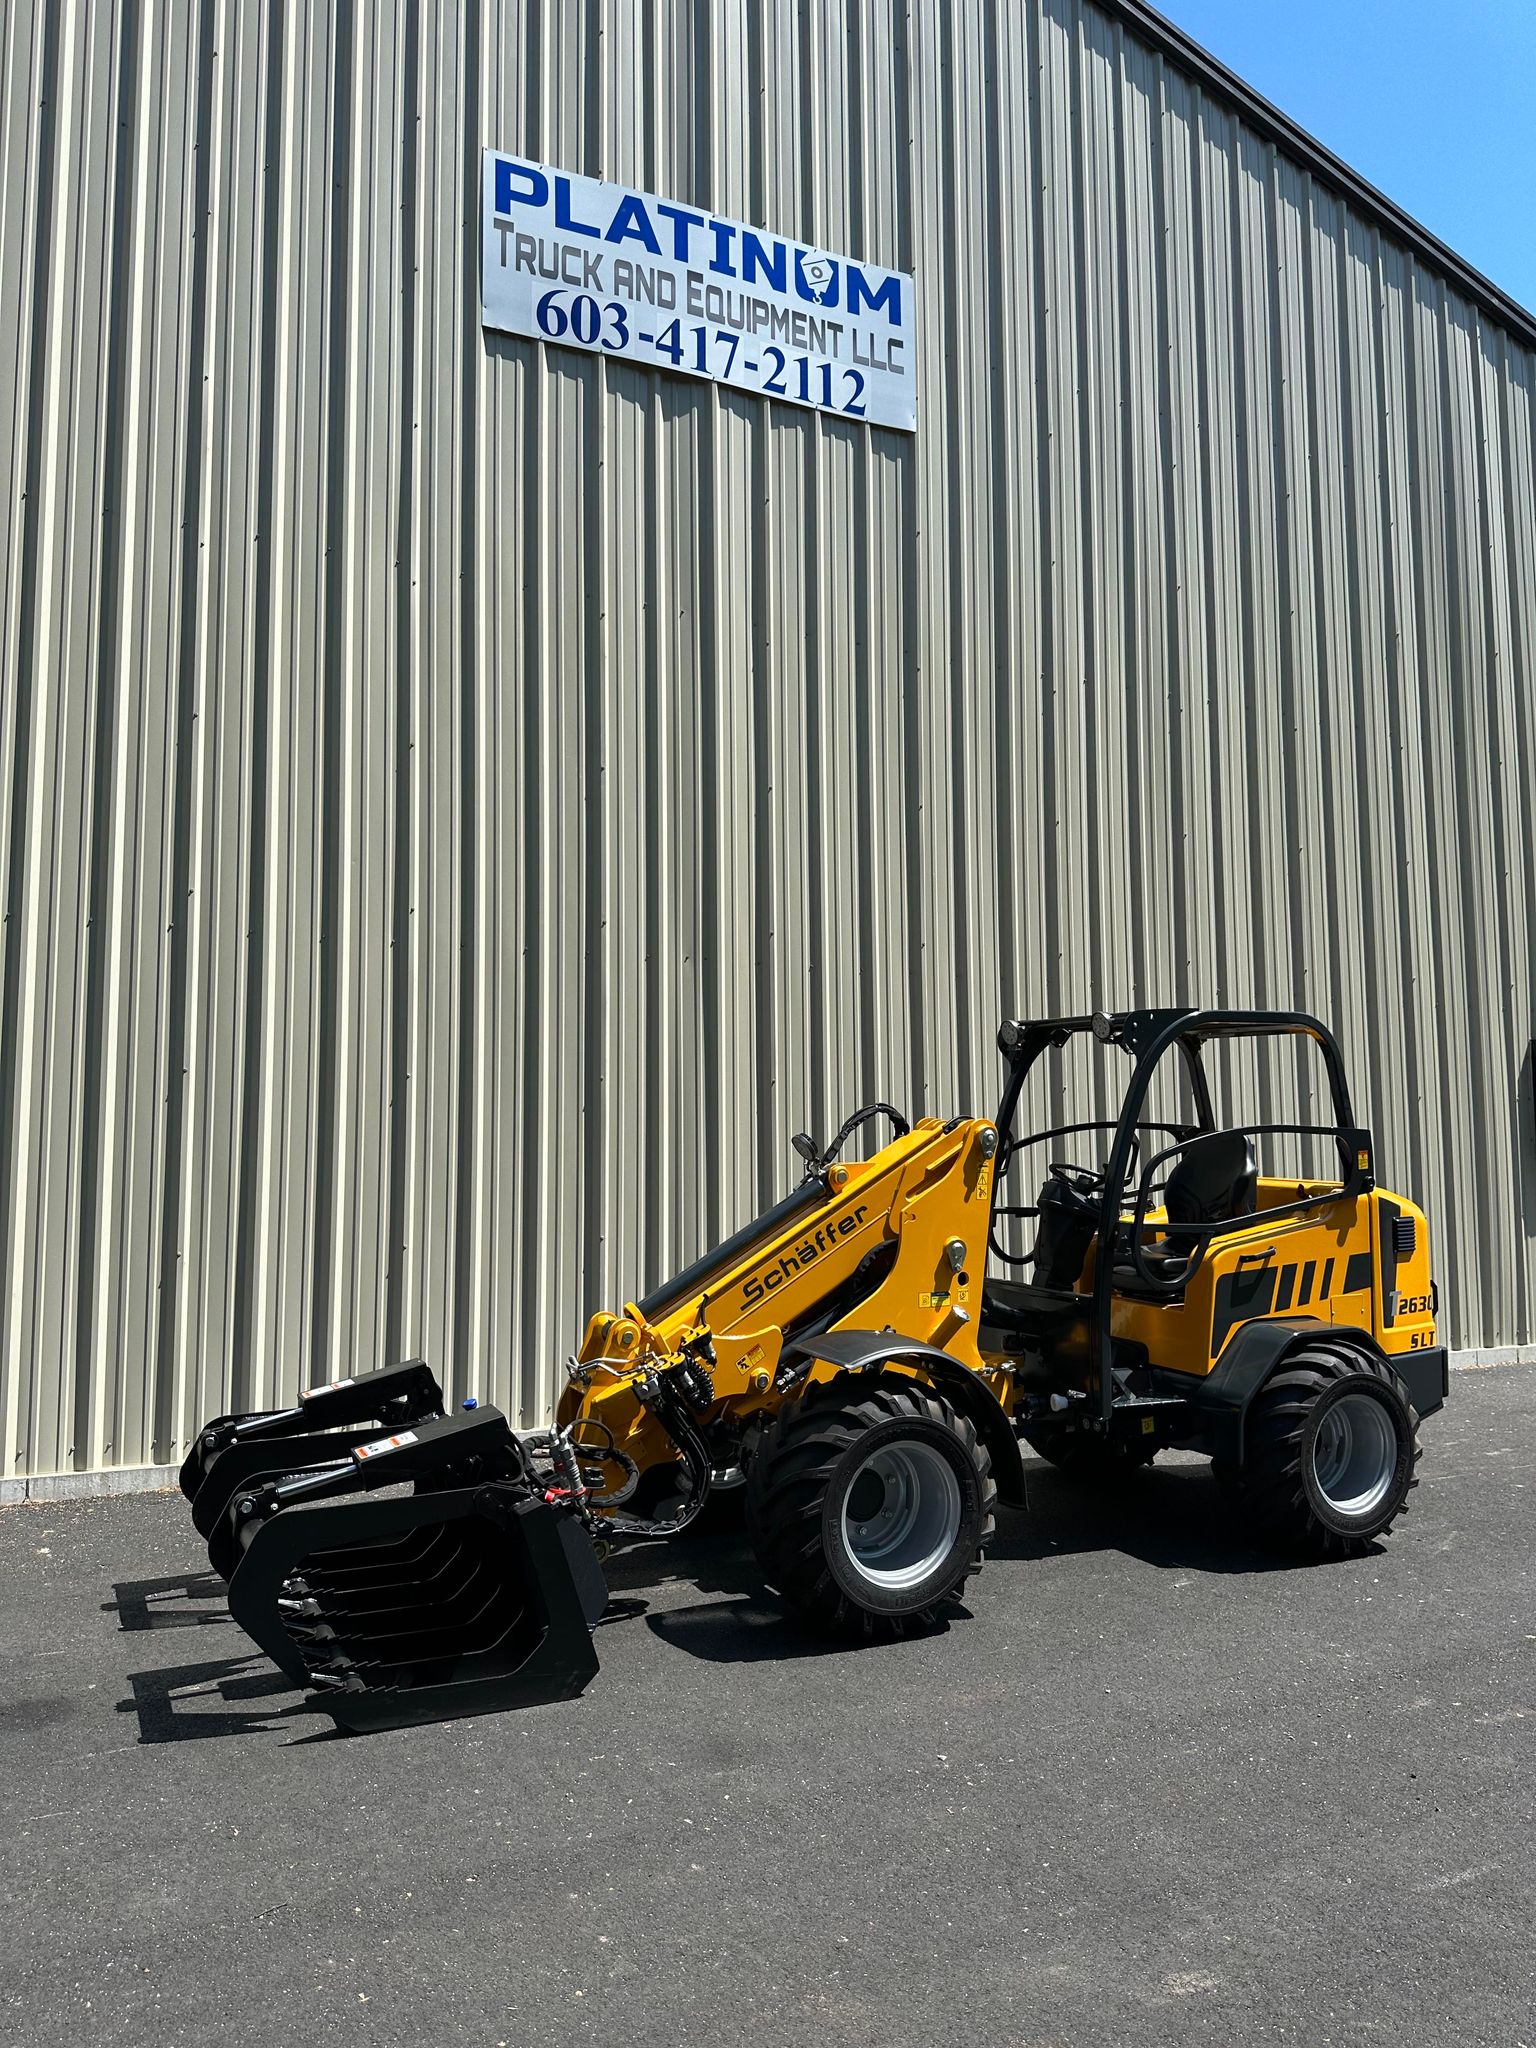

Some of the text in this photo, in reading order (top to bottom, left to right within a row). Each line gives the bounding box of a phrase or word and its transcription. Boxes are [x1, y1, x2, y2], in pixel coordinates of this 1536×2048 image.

[493, 217, 905, 375] TRUCK AND EQUIPMENT LLC
[494, 158, 902, 327] PLATINUM
[536, 289, 867, 416] 603-417-2112
[740, 1205, 868, 1311] Schäffer
[1410, 1330, 1435, 1349] SLT
